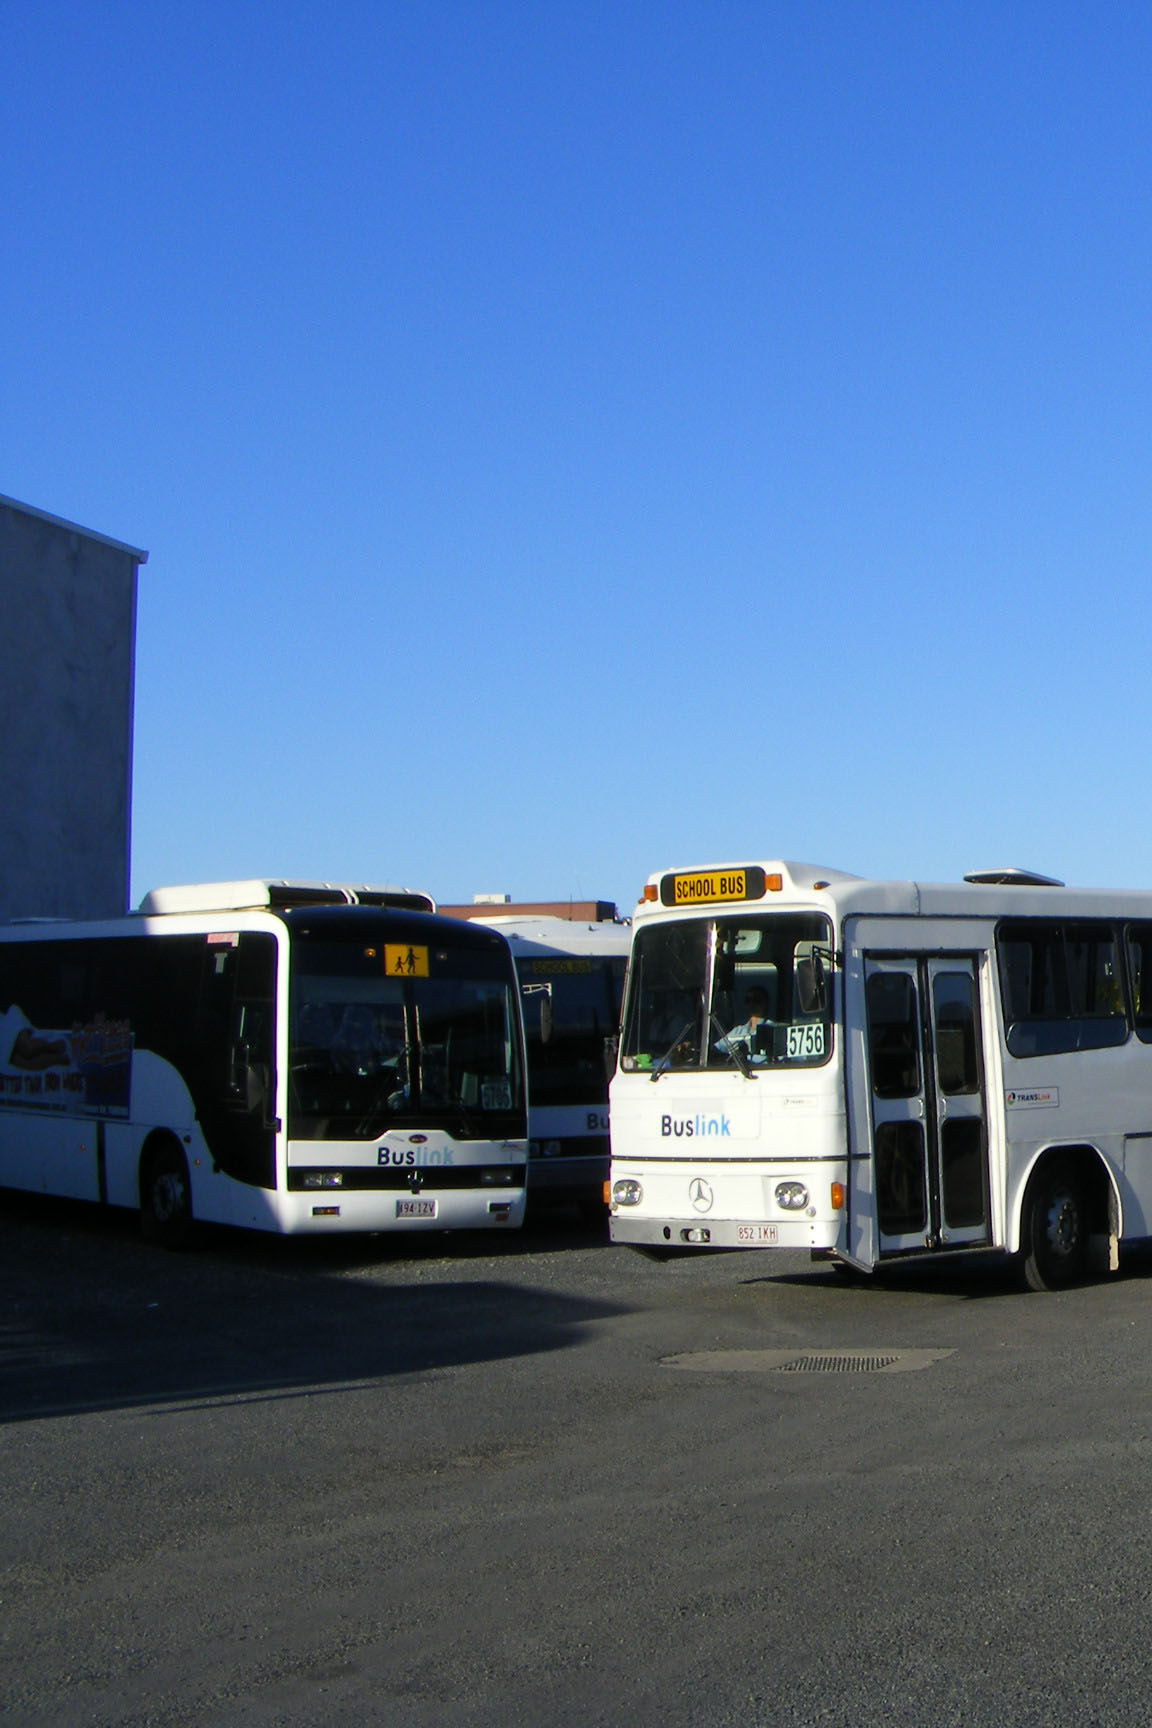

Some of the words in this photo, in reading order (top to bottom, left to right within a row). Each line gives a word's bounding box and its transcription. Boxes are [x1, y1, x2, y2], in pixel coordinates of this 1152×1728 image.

[676, 878, 716, 899] SCHOOL
[720, 876, 744, 895] BUS
[789, 1026, 822, 1055] 5756
[661, 1114, 731, 1137] Buslink
[377, 1146, 455, 1166] Buslink
[738, 1227, 754, 1240] 852
